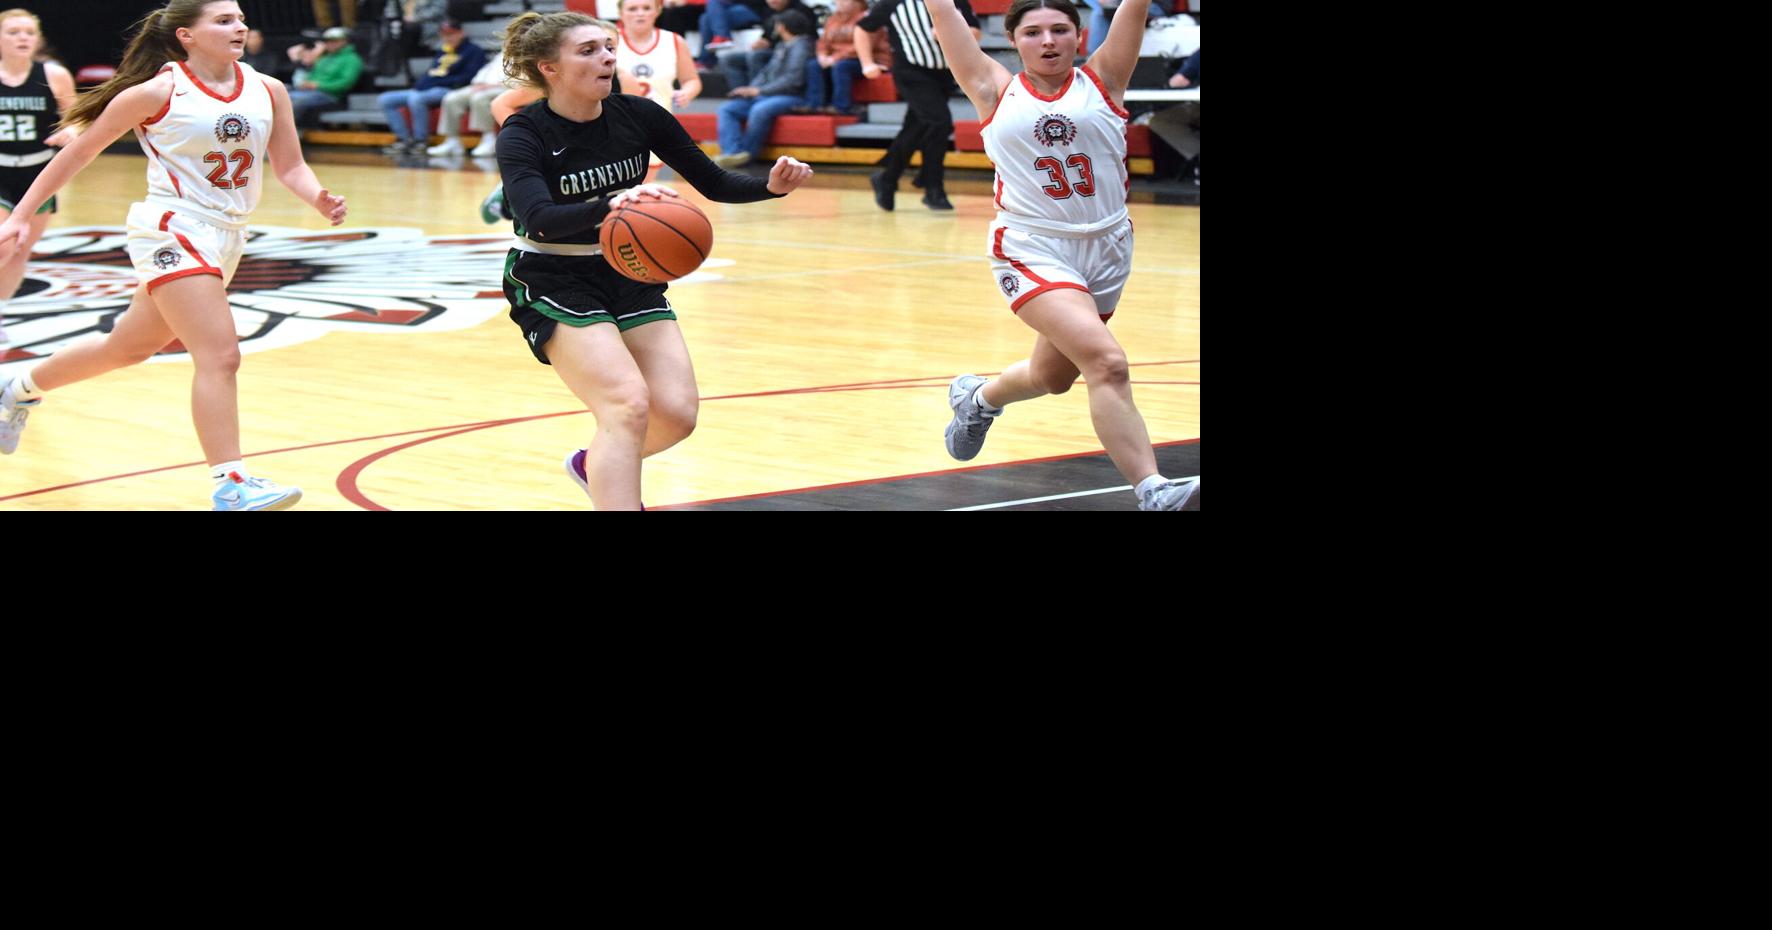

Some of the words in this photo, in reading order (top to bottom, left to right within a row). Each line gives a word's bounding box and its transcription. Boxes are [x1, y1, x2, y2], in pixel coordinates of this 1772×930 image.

[0, 114, 37, 141] 22
[203, 149, 254, 189] 22
[1034, 153, 1095, 200] 33
